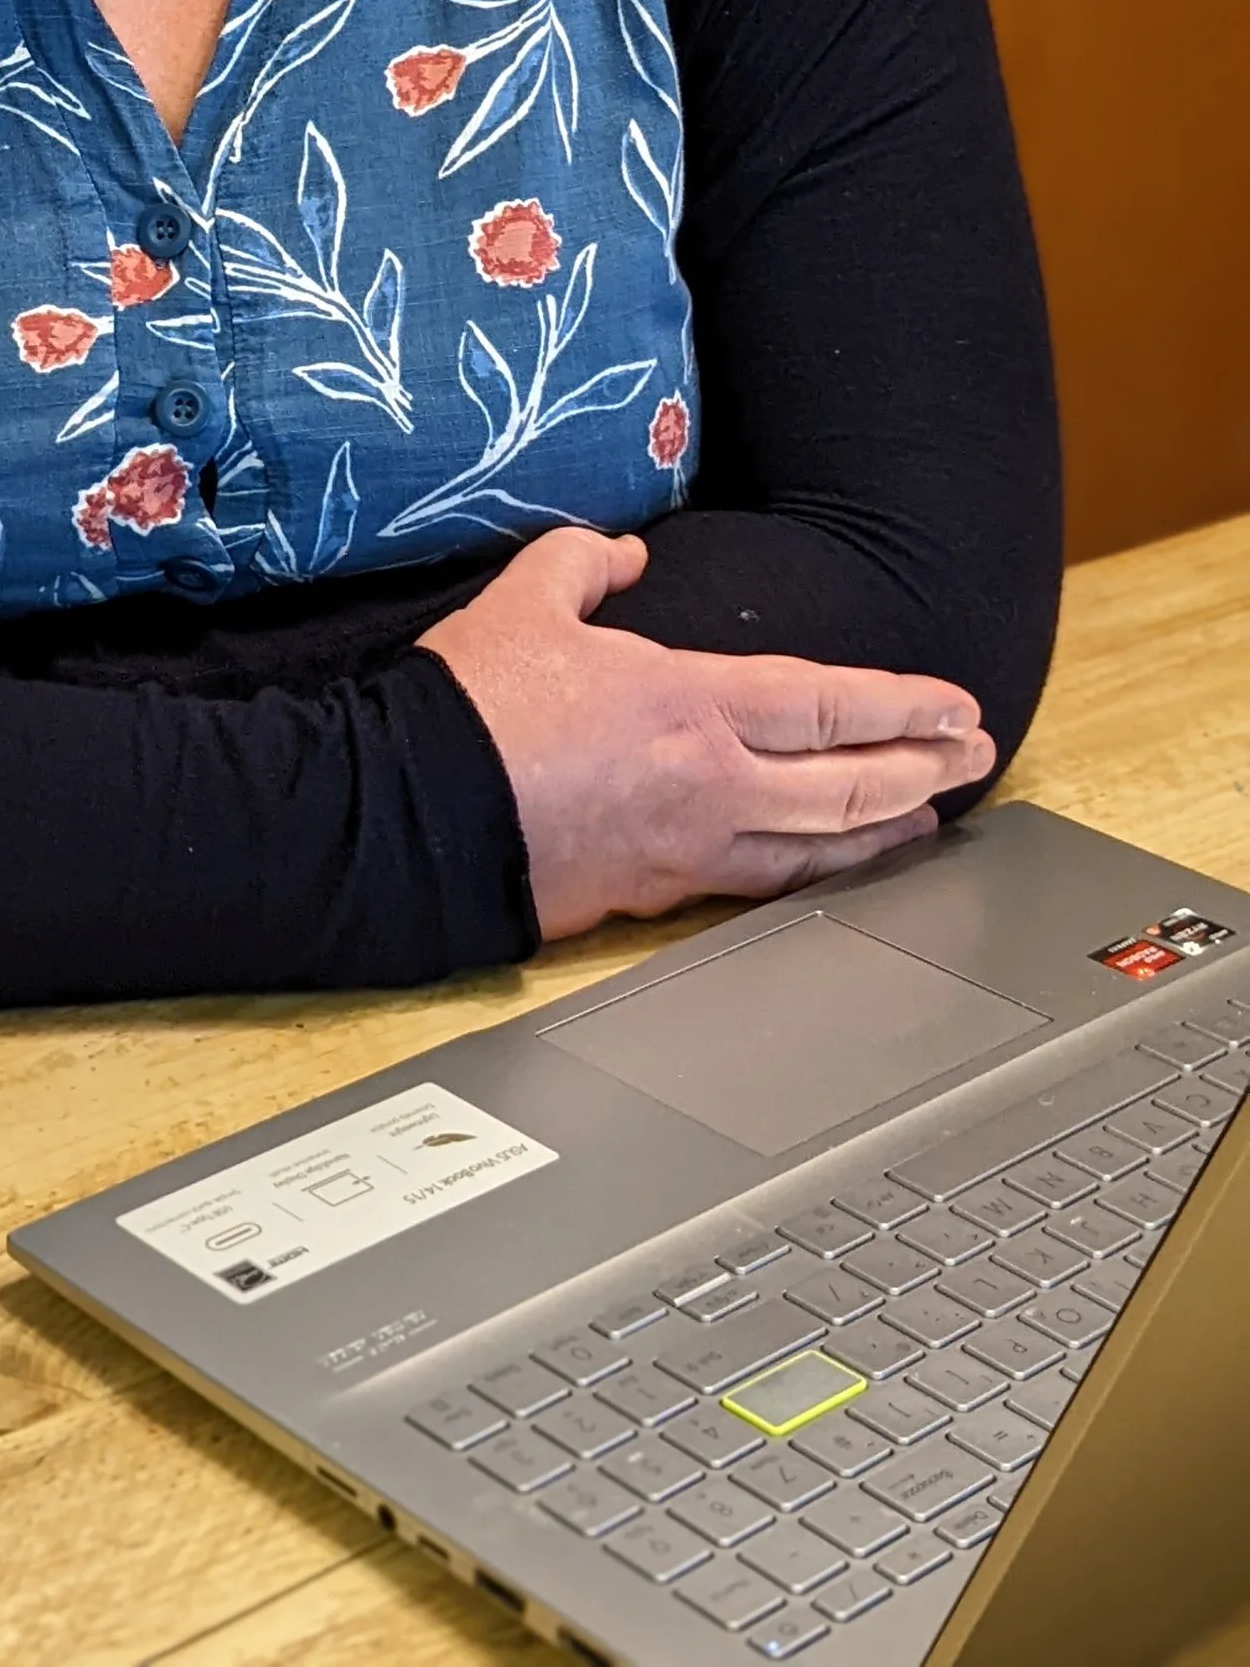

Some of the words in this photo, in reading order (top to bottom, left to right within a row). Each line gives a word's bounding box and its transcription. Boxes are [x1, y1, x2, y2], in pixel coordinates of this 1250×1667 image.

[494, 1142, 529, 1162] ASUS
[1035, 1171, 1066, 1188] N
[402, 1182, 444, 1205] 14/15
[1131, 1192, 1157, 1209] H
[981, 1197, 1013, 1217] M
[1026, 1247, 1054, 1265] K
[1055, 1307, 1082, 1324] O
[1007, 1338, 1029, 1354] P
[778, 1465, 798, 1484] 7
[709, 1500, 734, 1517] 8
